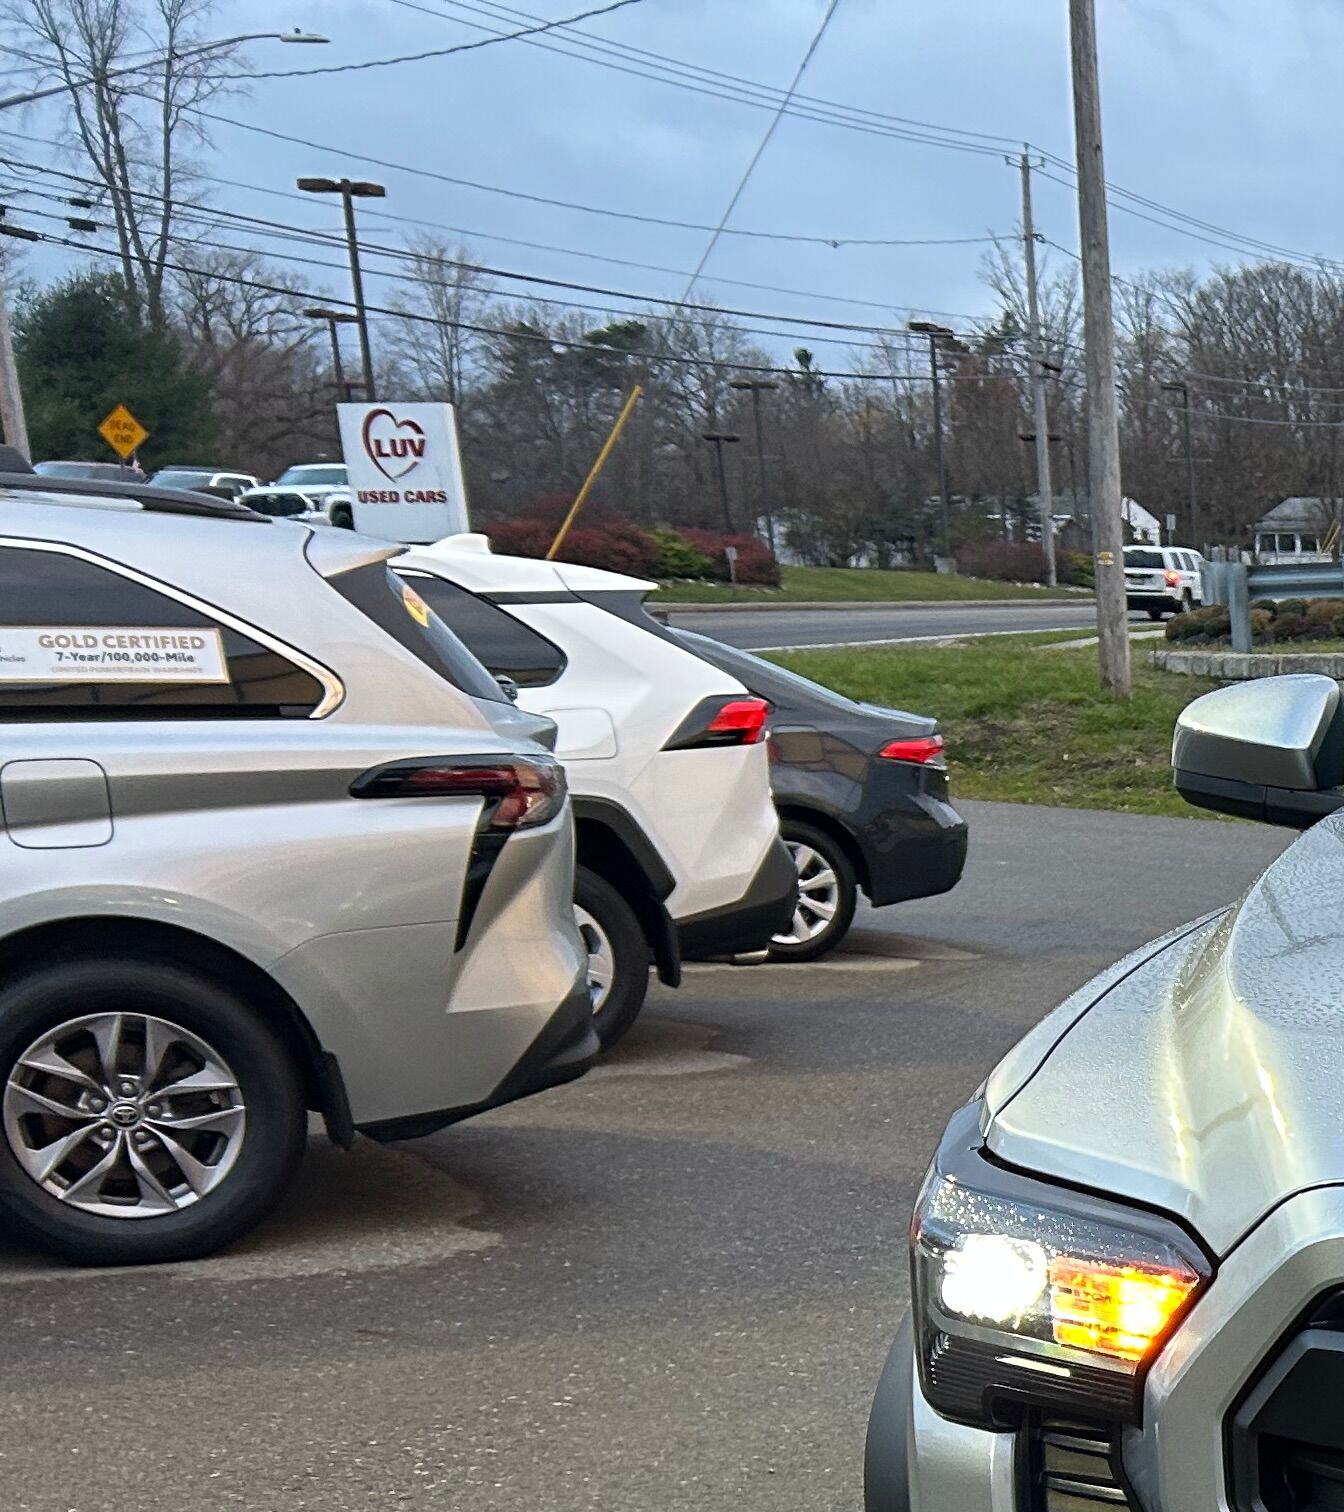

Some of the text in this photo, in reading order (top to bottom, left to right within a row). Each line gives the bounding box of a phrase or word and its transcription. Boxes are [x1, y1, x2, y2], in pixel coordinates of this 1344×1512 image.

[109, 419, 136, 432] DEAD
[113, 434, 134, 444] END
[374, 439, 426, 458] LUV
[358, 490, 448, 504] USED CARS
[38, 634, 205, 650] GOLD CERTIFIED
[55, 651, 195, 663] 7-Year/100,000-Mile
